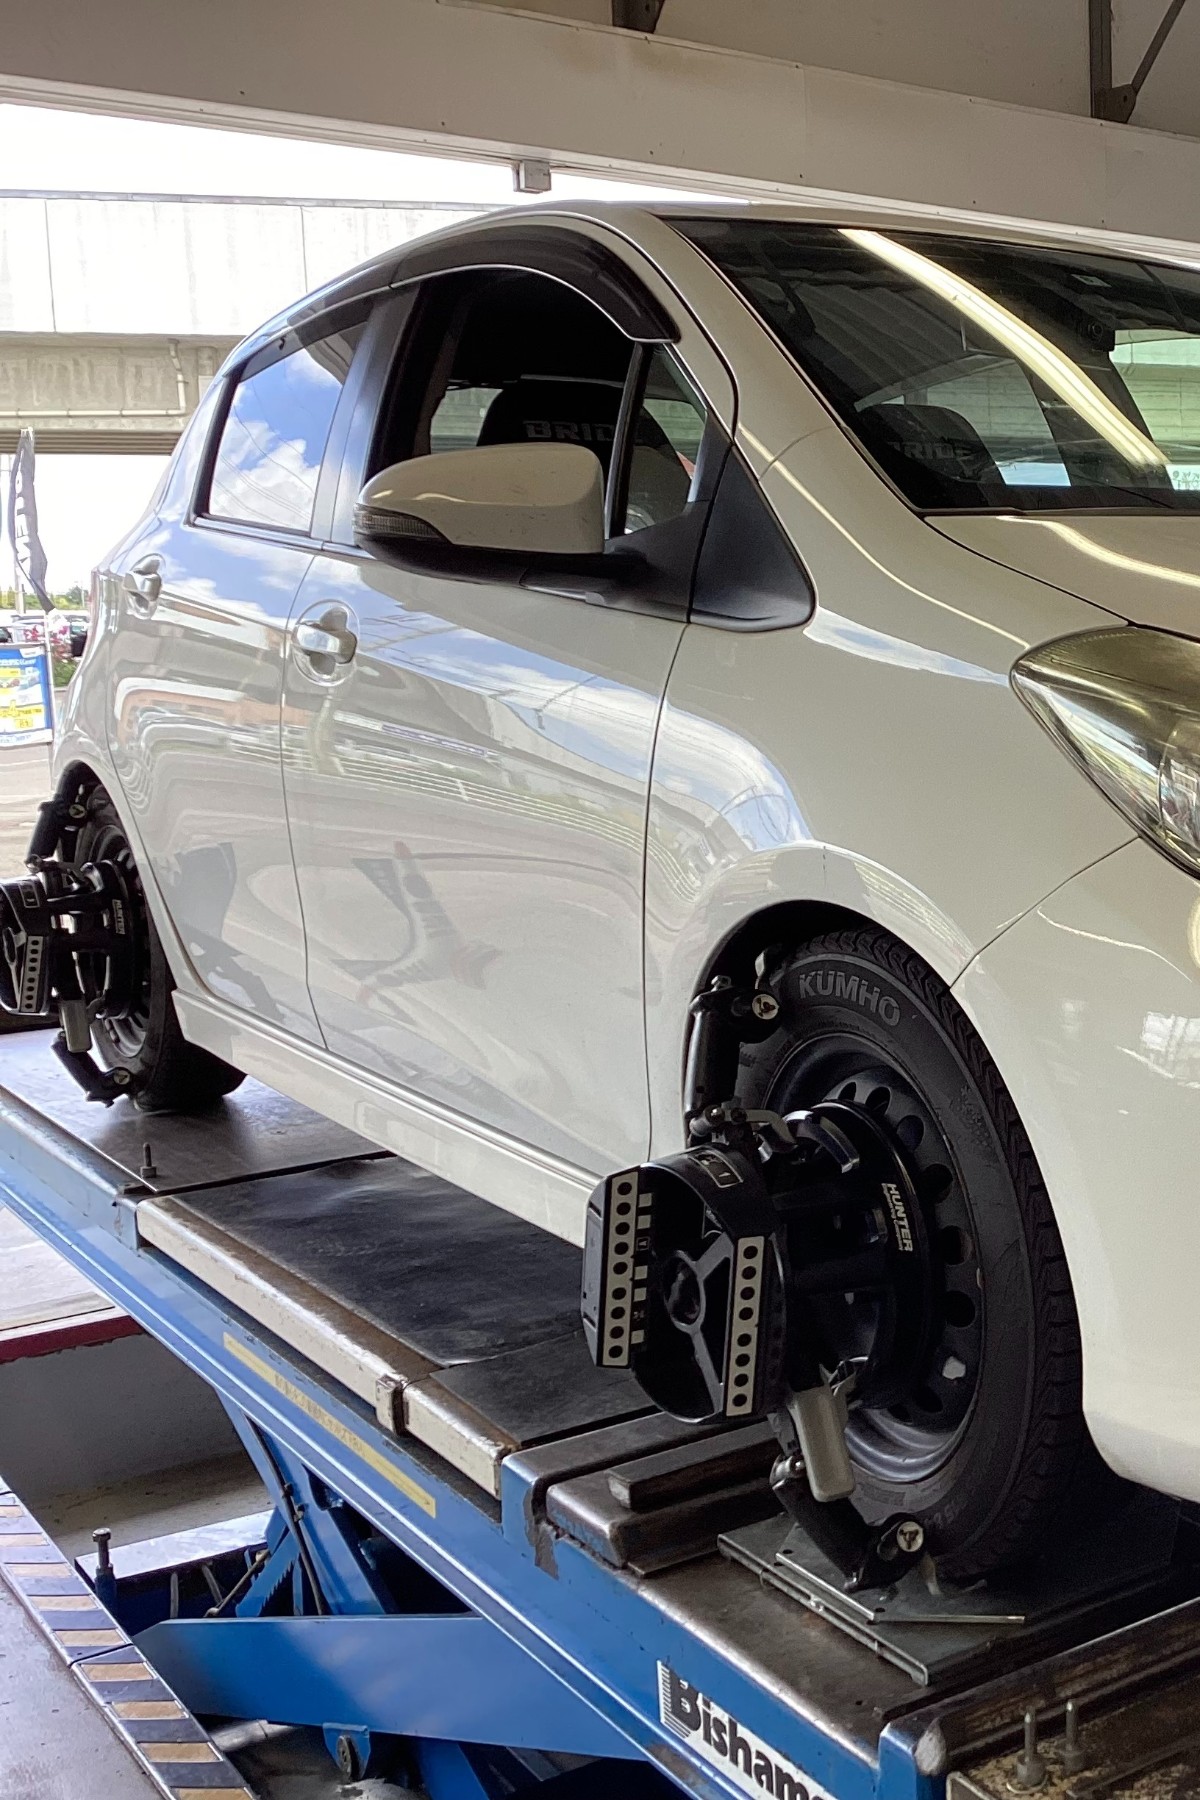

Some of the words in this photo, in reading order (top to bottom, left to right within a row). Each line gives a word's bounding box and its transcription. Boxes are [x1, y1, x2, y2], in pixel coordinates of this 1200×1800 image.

[523, 420, 643, 443] BRID
[798, 969, 901, 1027] KUMHO
[886, 1183, 913, 1252] HUNTER
[660, 1664, 828, 1800] Bisham
